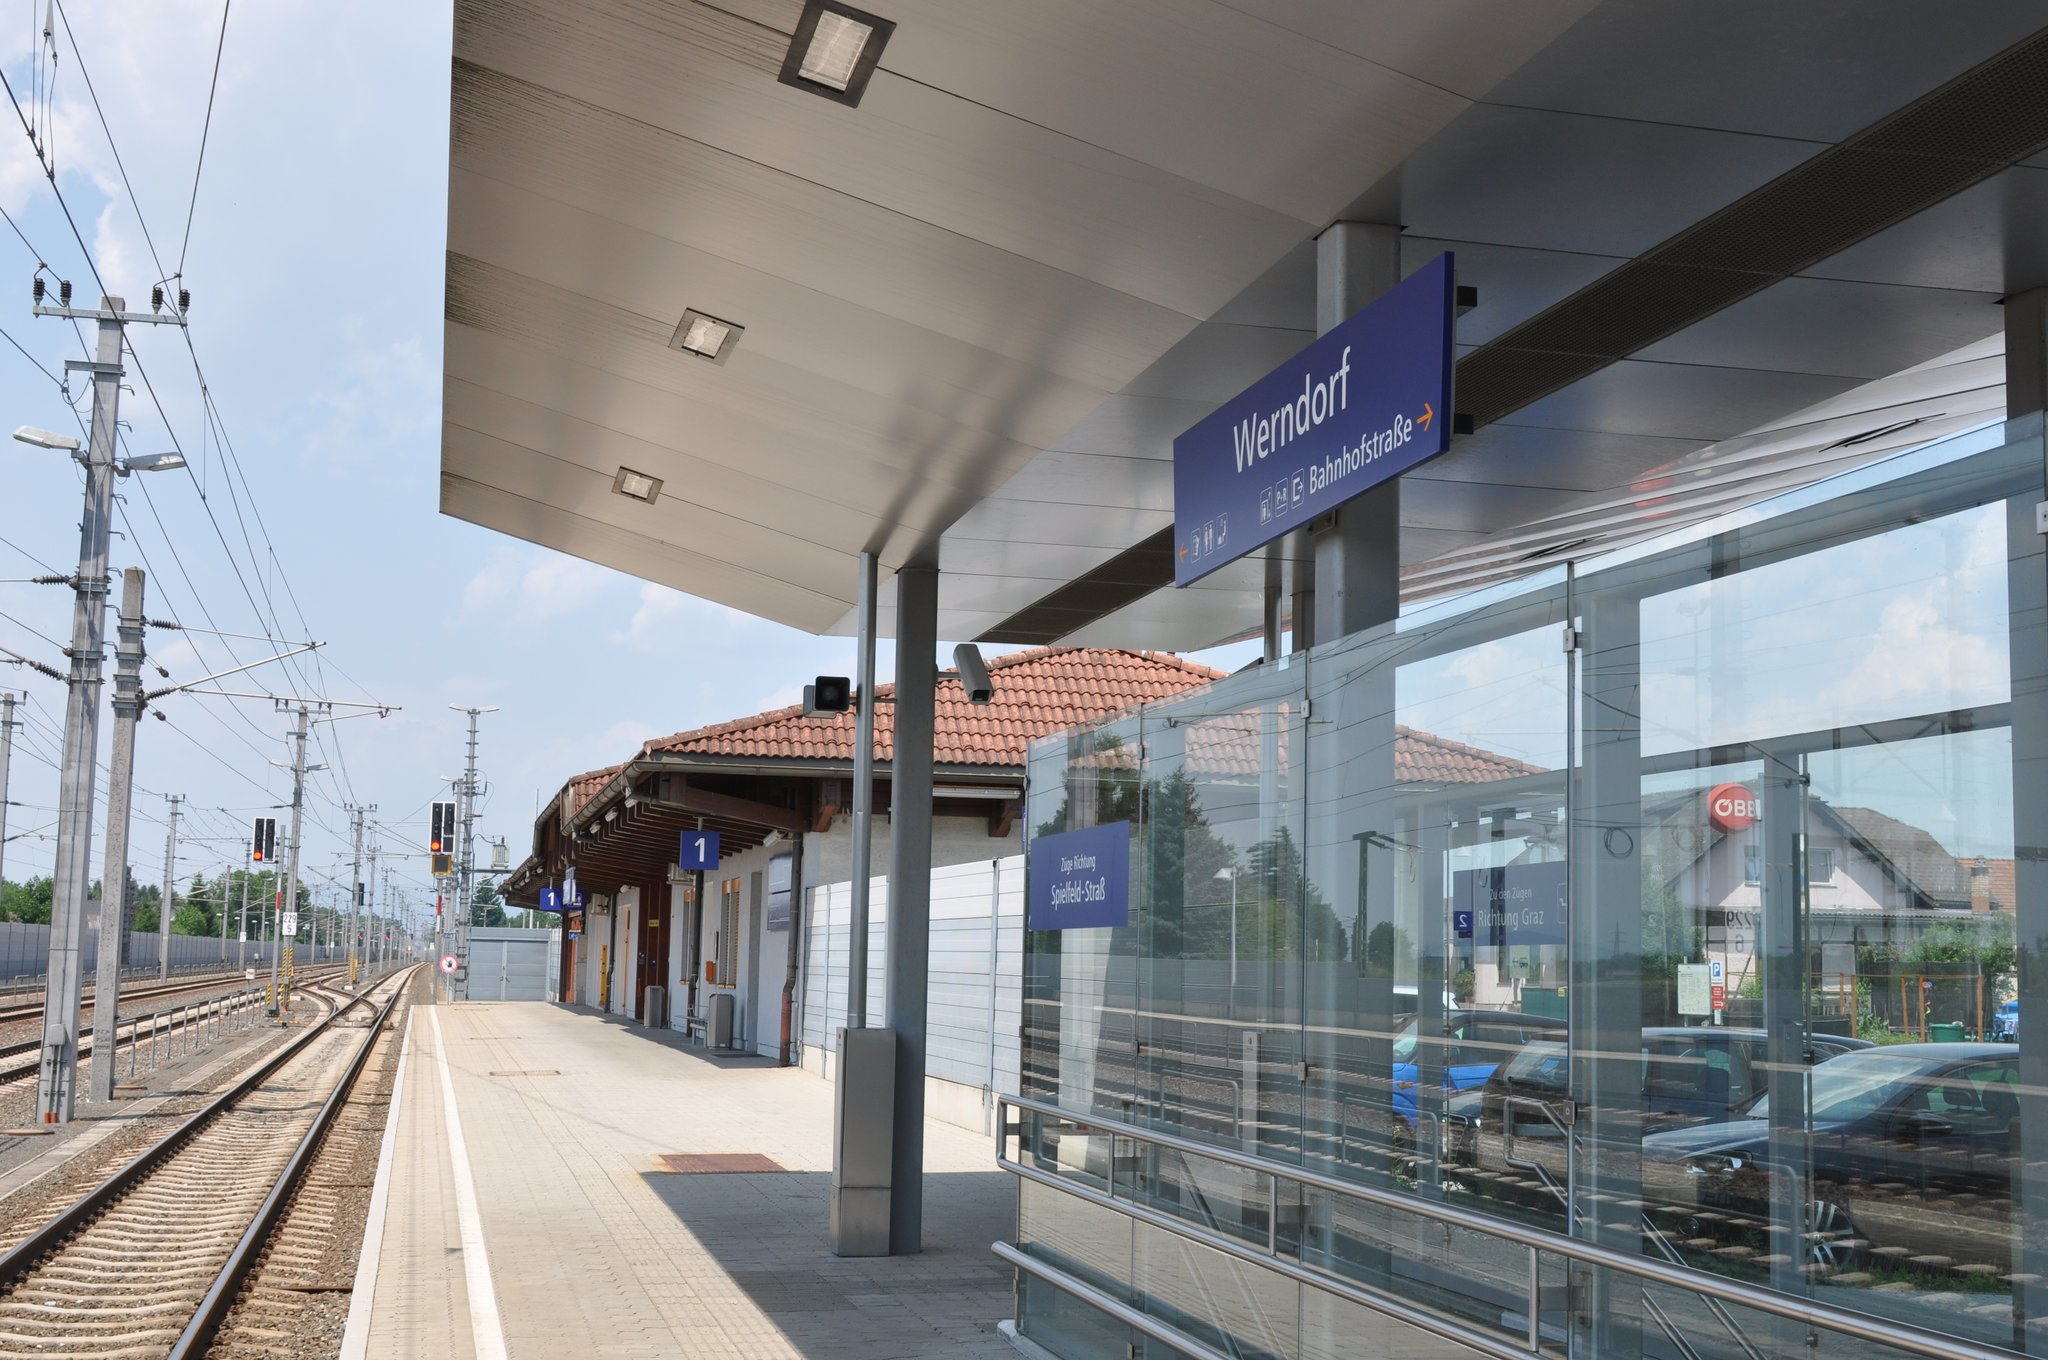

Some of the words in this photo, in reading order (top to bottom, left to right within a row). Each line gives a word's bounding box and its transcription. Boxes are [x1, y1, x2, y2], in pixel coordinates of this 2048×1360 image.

[1233, 346, 1351, 474] Werndorf
[1309, 413, 1412, 494] Bahnhofstraße
[694, 837, 706, 863] 1
[1060, 857, 1073, 875] Züge
[1073, 853, 1096, 872] Richtung
[547, 891, 555, 906] 1
[1512, 887, 1532, 902] Zügen
[283, 914, 297, 923] 229
[287, 924, 292, 933] 5
[1478, 909, 1519, 930] Richtung
[1522, 908, 1544, 925] Graz
